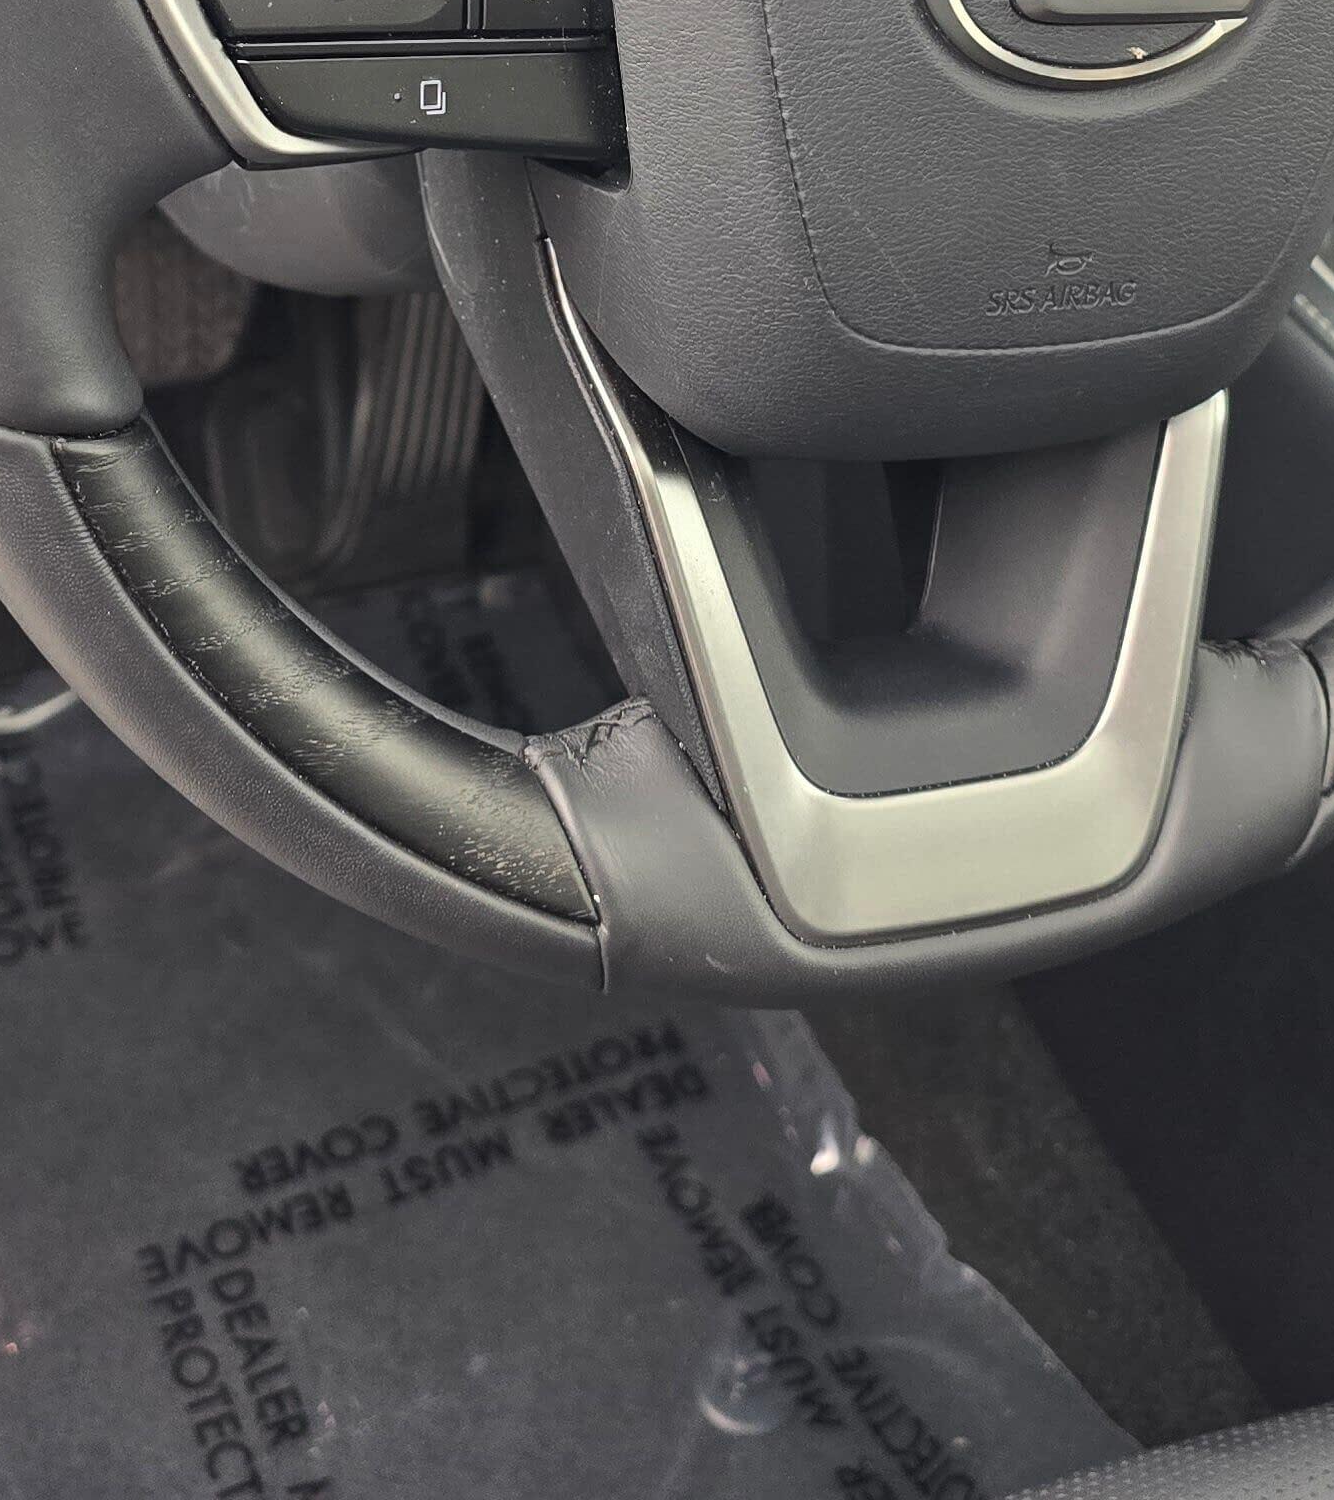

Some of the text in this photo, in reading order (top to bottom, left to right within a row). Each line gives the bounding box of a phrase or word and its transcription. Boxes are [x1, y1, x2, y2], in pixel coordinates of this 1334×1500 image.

[985, 280, 1138, 317] SRS AIRBAG
[229, 1113, 401, 1196] COVER
[380, 1126, 514, 1205] MUST
[135, 1180, 357, 1288] REMOVE
[154, 1282, 264, 1500] PROTECT
[210, 1267, 312, 1453] DEALER
[740, 1304, 845, 1430] MUST
